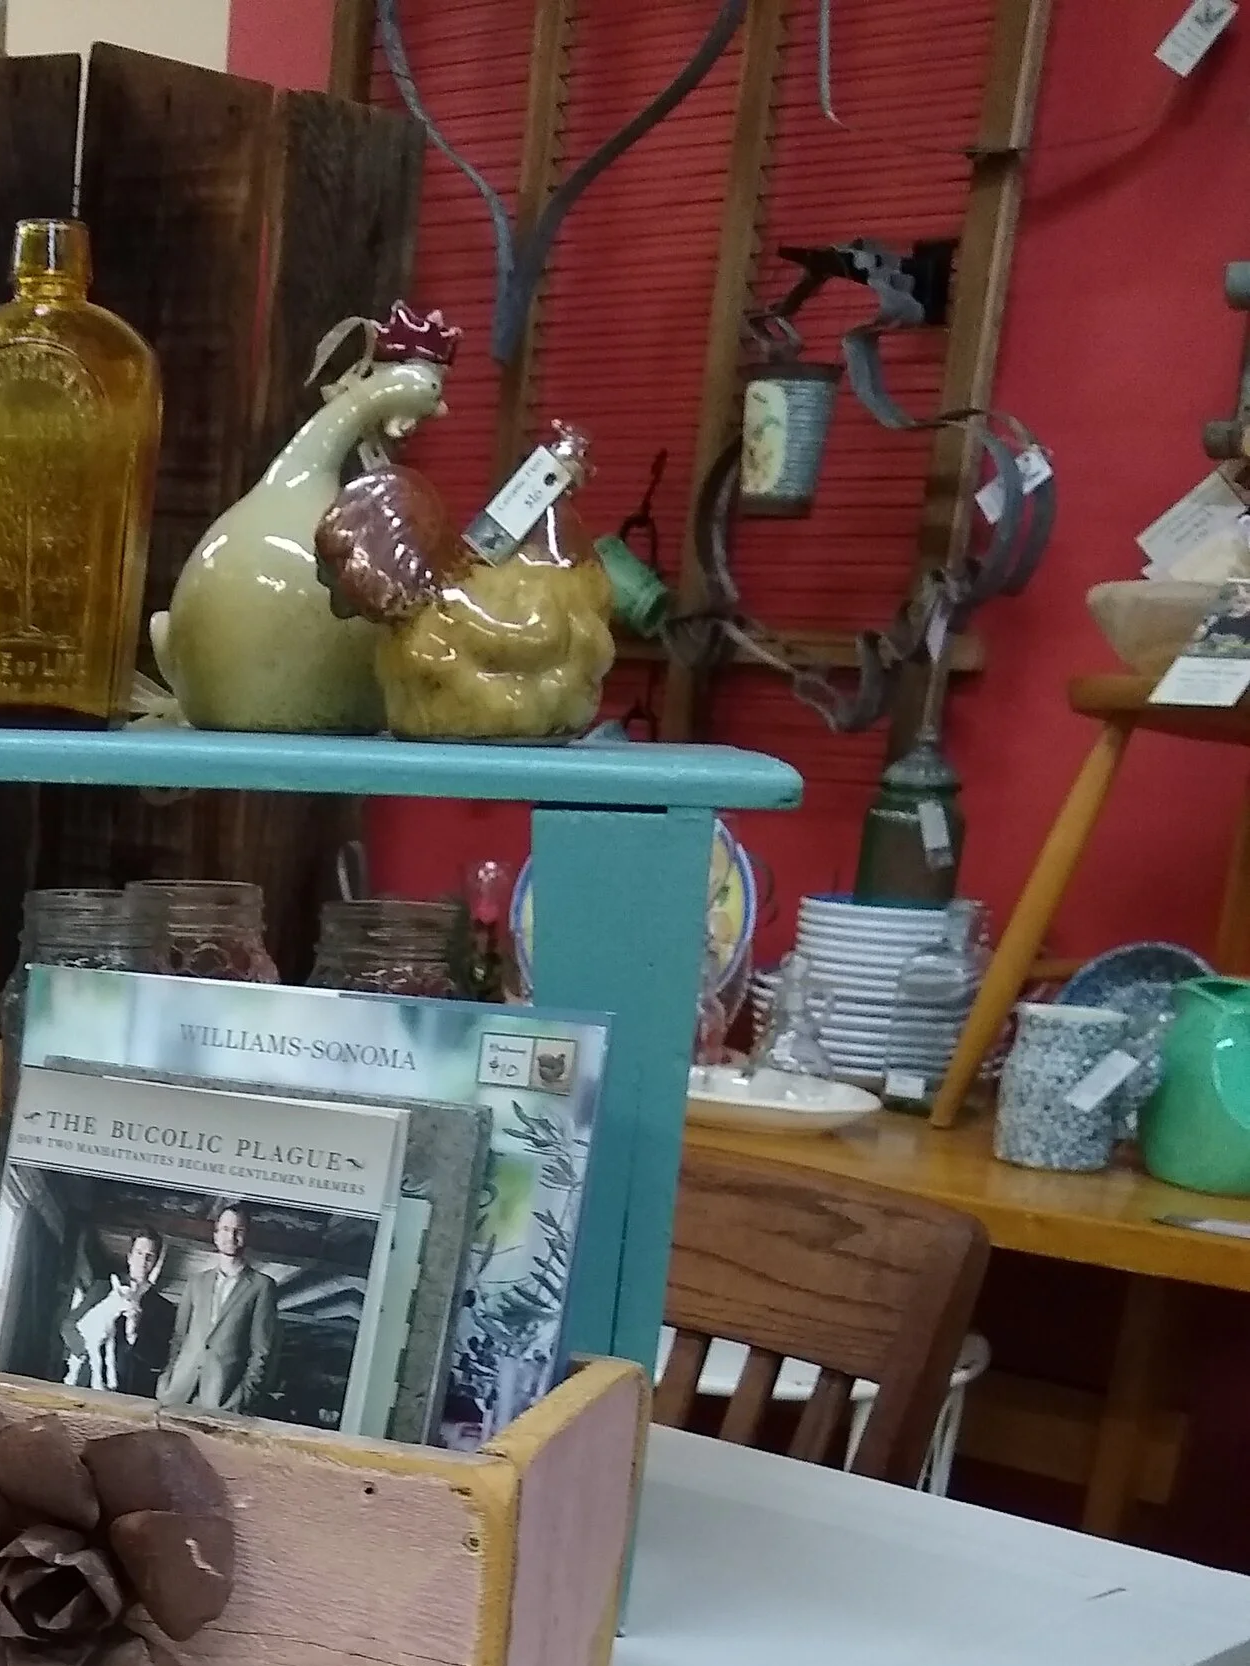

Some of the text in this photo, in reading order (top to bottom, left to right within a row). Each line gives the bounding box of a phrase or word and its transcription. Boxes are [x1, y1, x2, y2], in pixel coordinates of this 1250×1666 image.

[180, 1023, 417, 1071] WILLIAMS-SONOMA
[47, 1110, 342, 1171] THE BUCOLIC PLAGUE
[48, 1137, 73, 1150] TWO
[77, 1142, 174, 1166] MANHATTANITES
[178, 1157, 226, 1175] BECAME
[228, 1165, 304, 1186] GENTLEMEN
